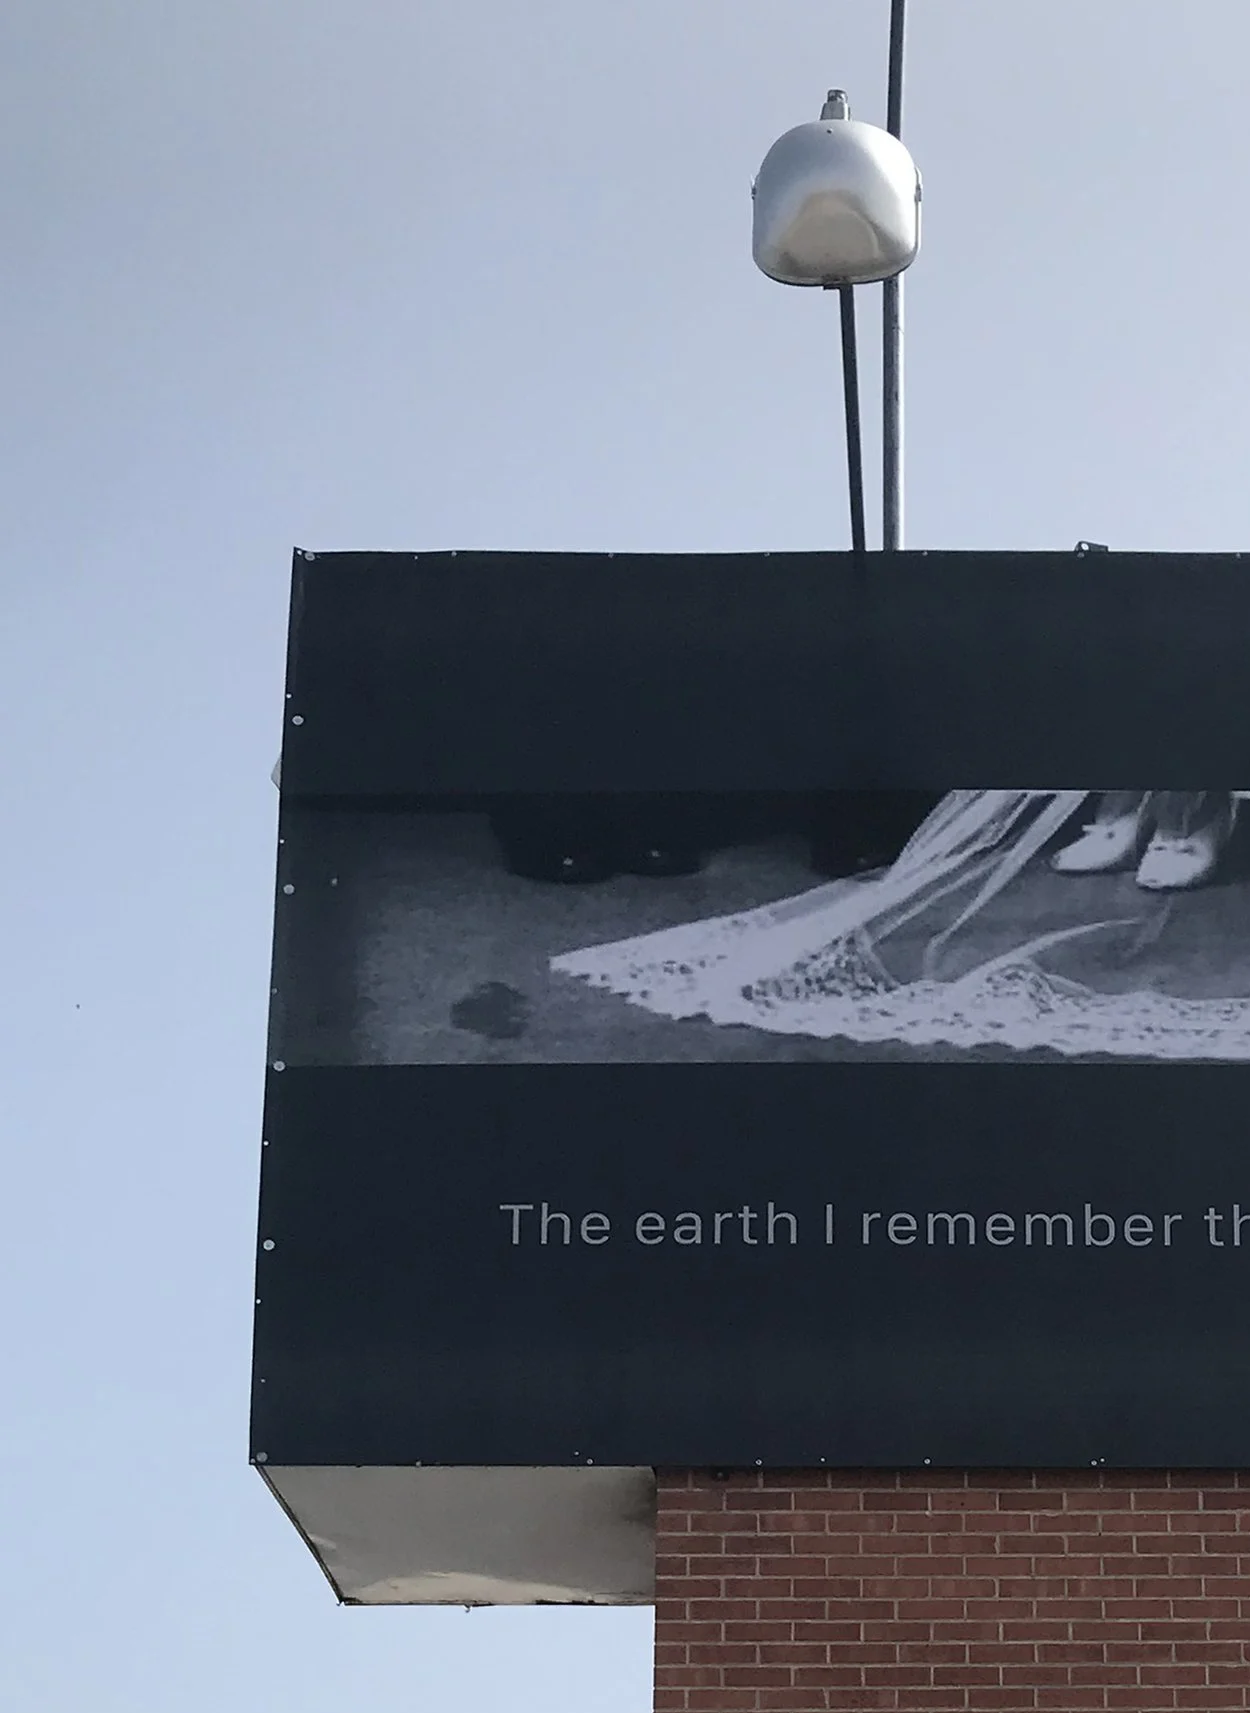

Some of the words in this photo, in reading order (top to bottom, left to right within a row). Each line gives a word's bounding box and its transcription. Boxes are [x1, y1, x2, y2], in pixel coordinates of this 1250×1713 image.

[499, 1202, 611, 1245] The
[635, 1202, 797, 1245] earth
[825, 1204, 833, 1245] I
[862, 1203, 1183, 1247] remember
